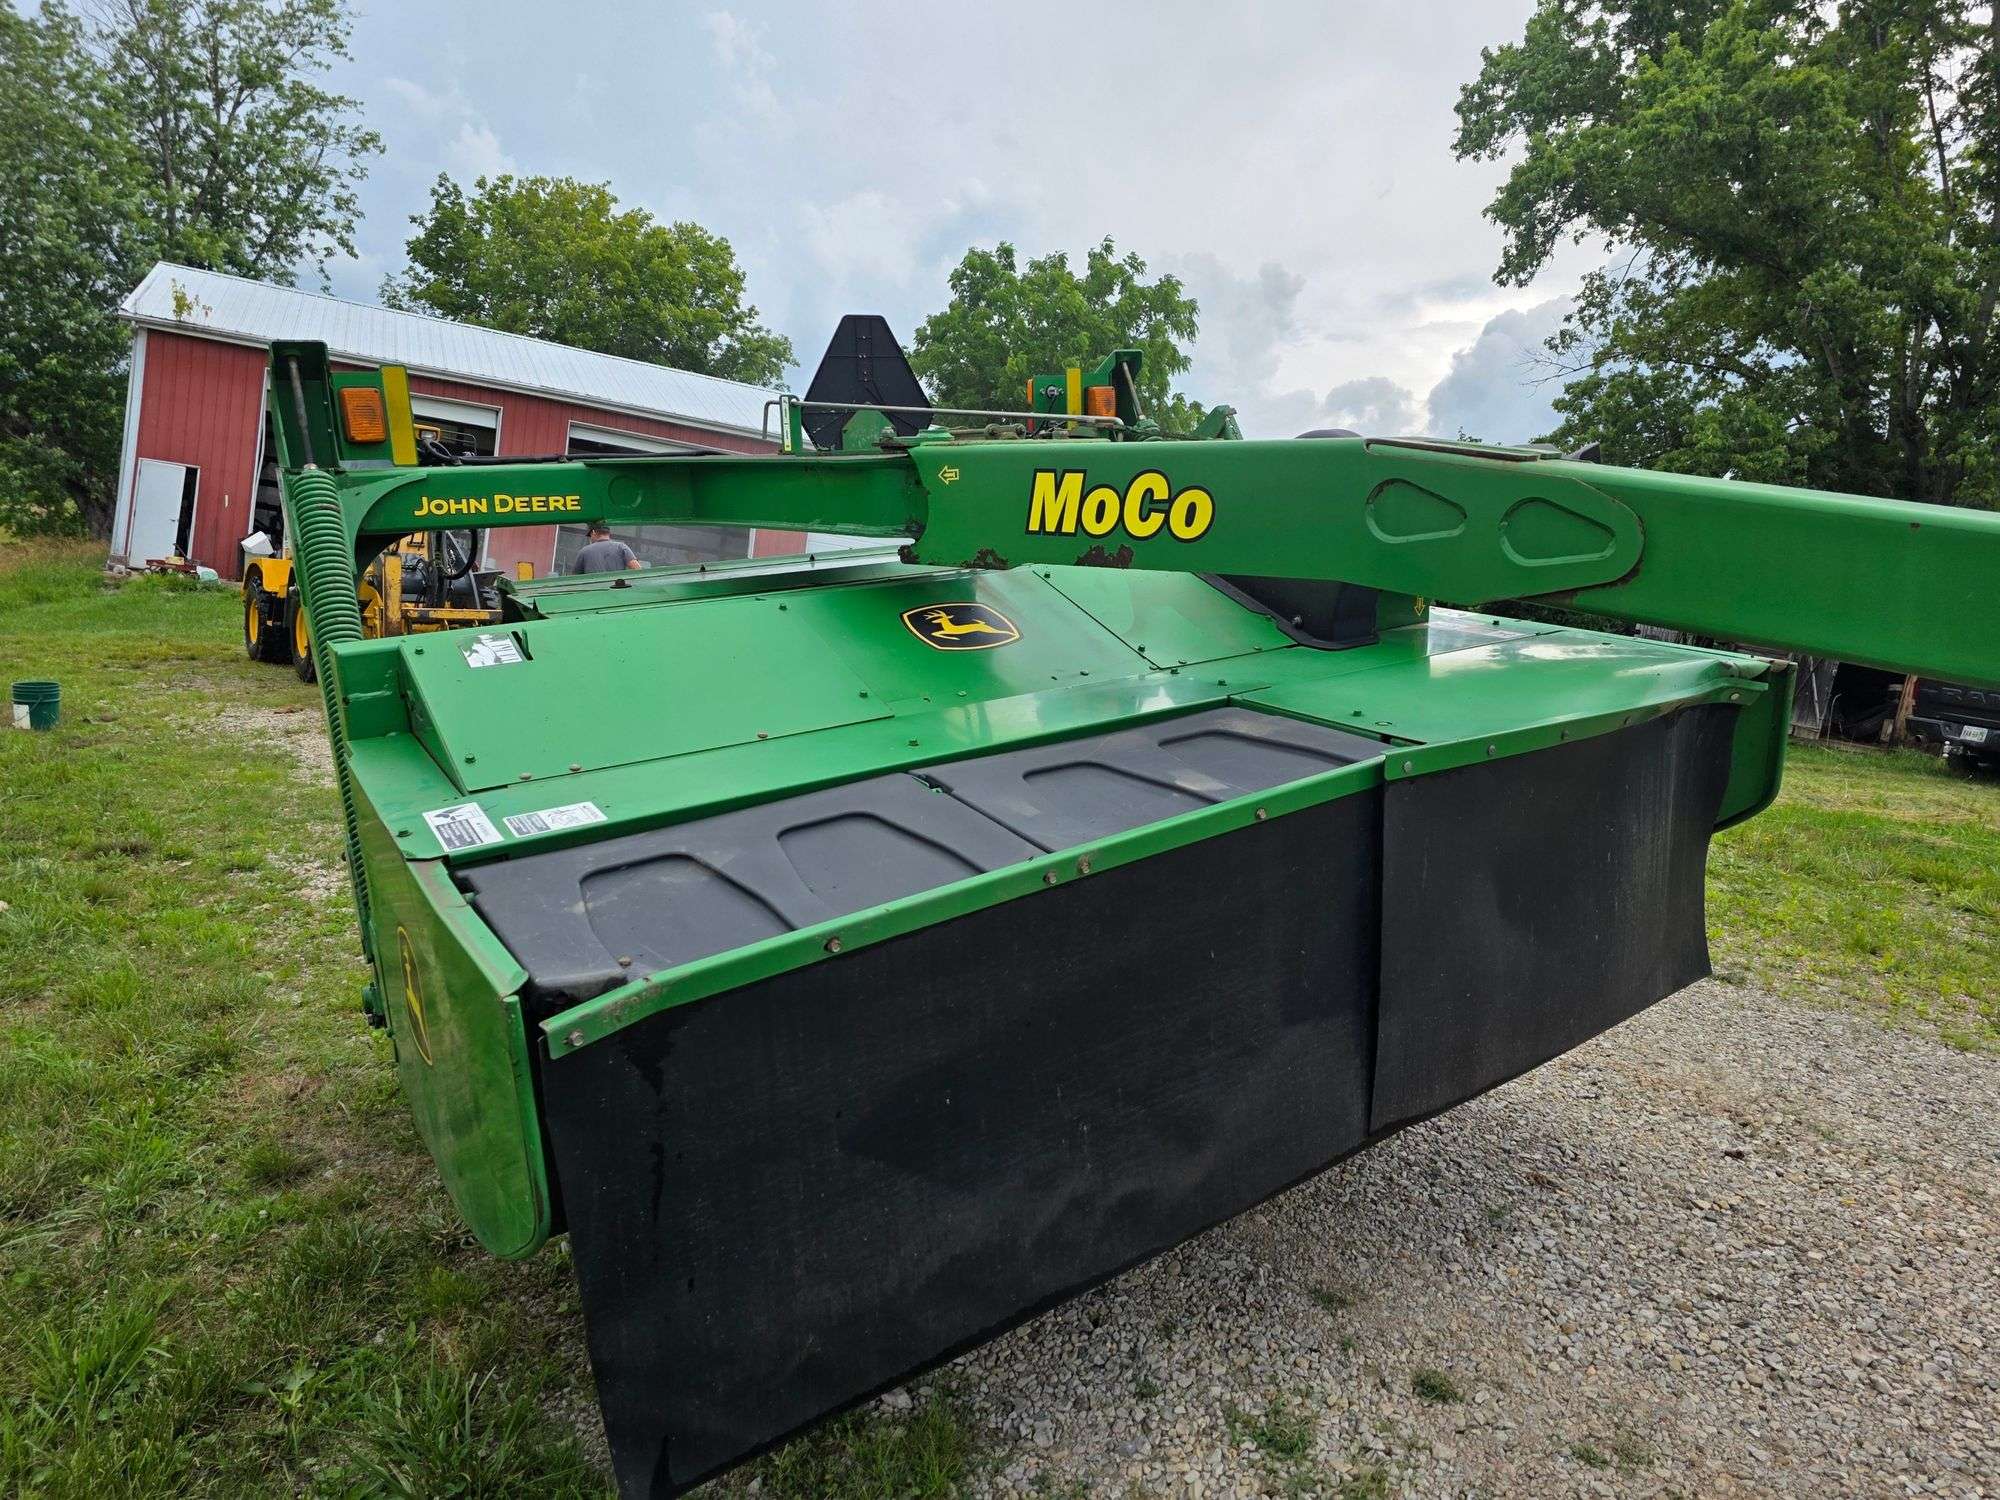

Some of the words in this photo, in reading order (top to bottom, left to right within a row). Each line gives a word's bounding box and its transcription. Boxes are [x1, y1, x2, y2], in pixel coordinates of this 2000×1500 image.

[414, 496, 488, 516] JOHN
[494, 494, 581, 513] DEERE
[1026, 469, 1215, 542] MoCo
